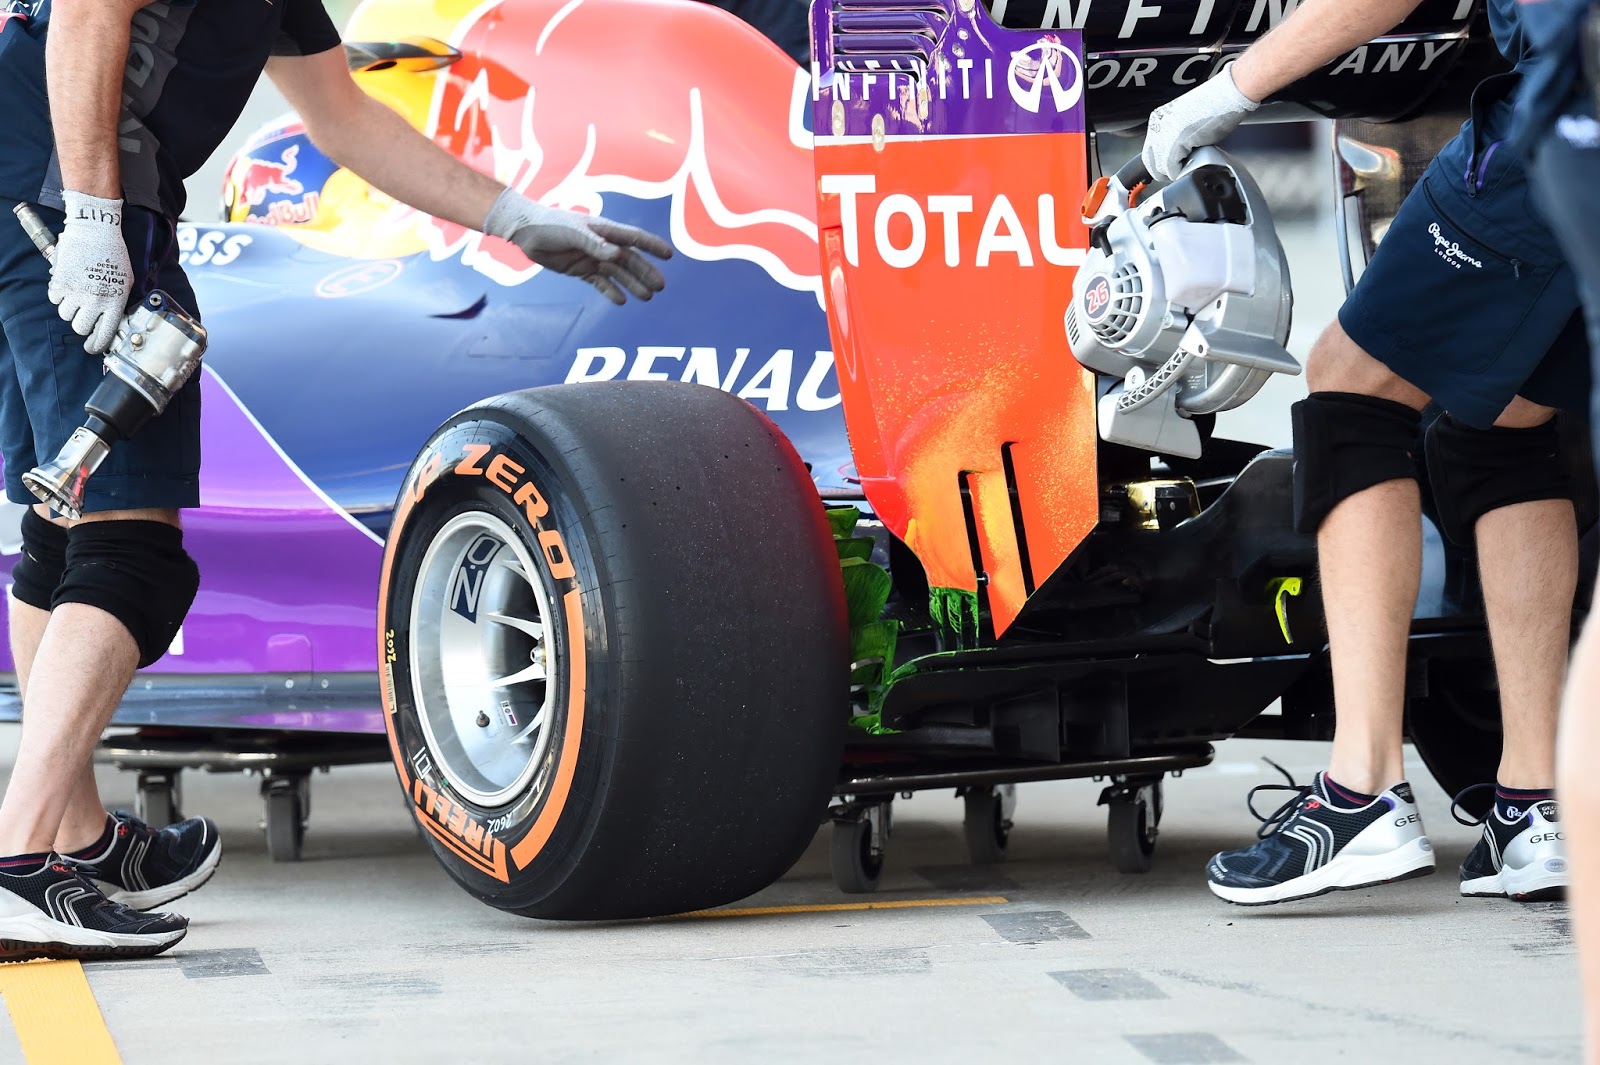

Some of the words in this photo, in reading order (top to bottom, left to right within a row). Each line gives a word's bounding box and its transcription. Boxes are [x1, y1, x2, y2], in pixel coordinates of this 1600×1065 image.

[812, 58, 993, 101] INFINITI
[821, 174, 1087, 269] TOTAL
[176, 227, 253, 266] ess
[1428, 222, 1450, 248] Pepe
[1446, 242, 1482, 268] Jeans
[1434, 247, 1462, 269] LONDON
[88, 274, 124, 286] Polyco
[1086, 280, 1109, 315] 26
[564, 346, 842, 411] RENAU
[454, 444, 576, 579] ZERO
[414, 779, 510, 884] PIRELLI
